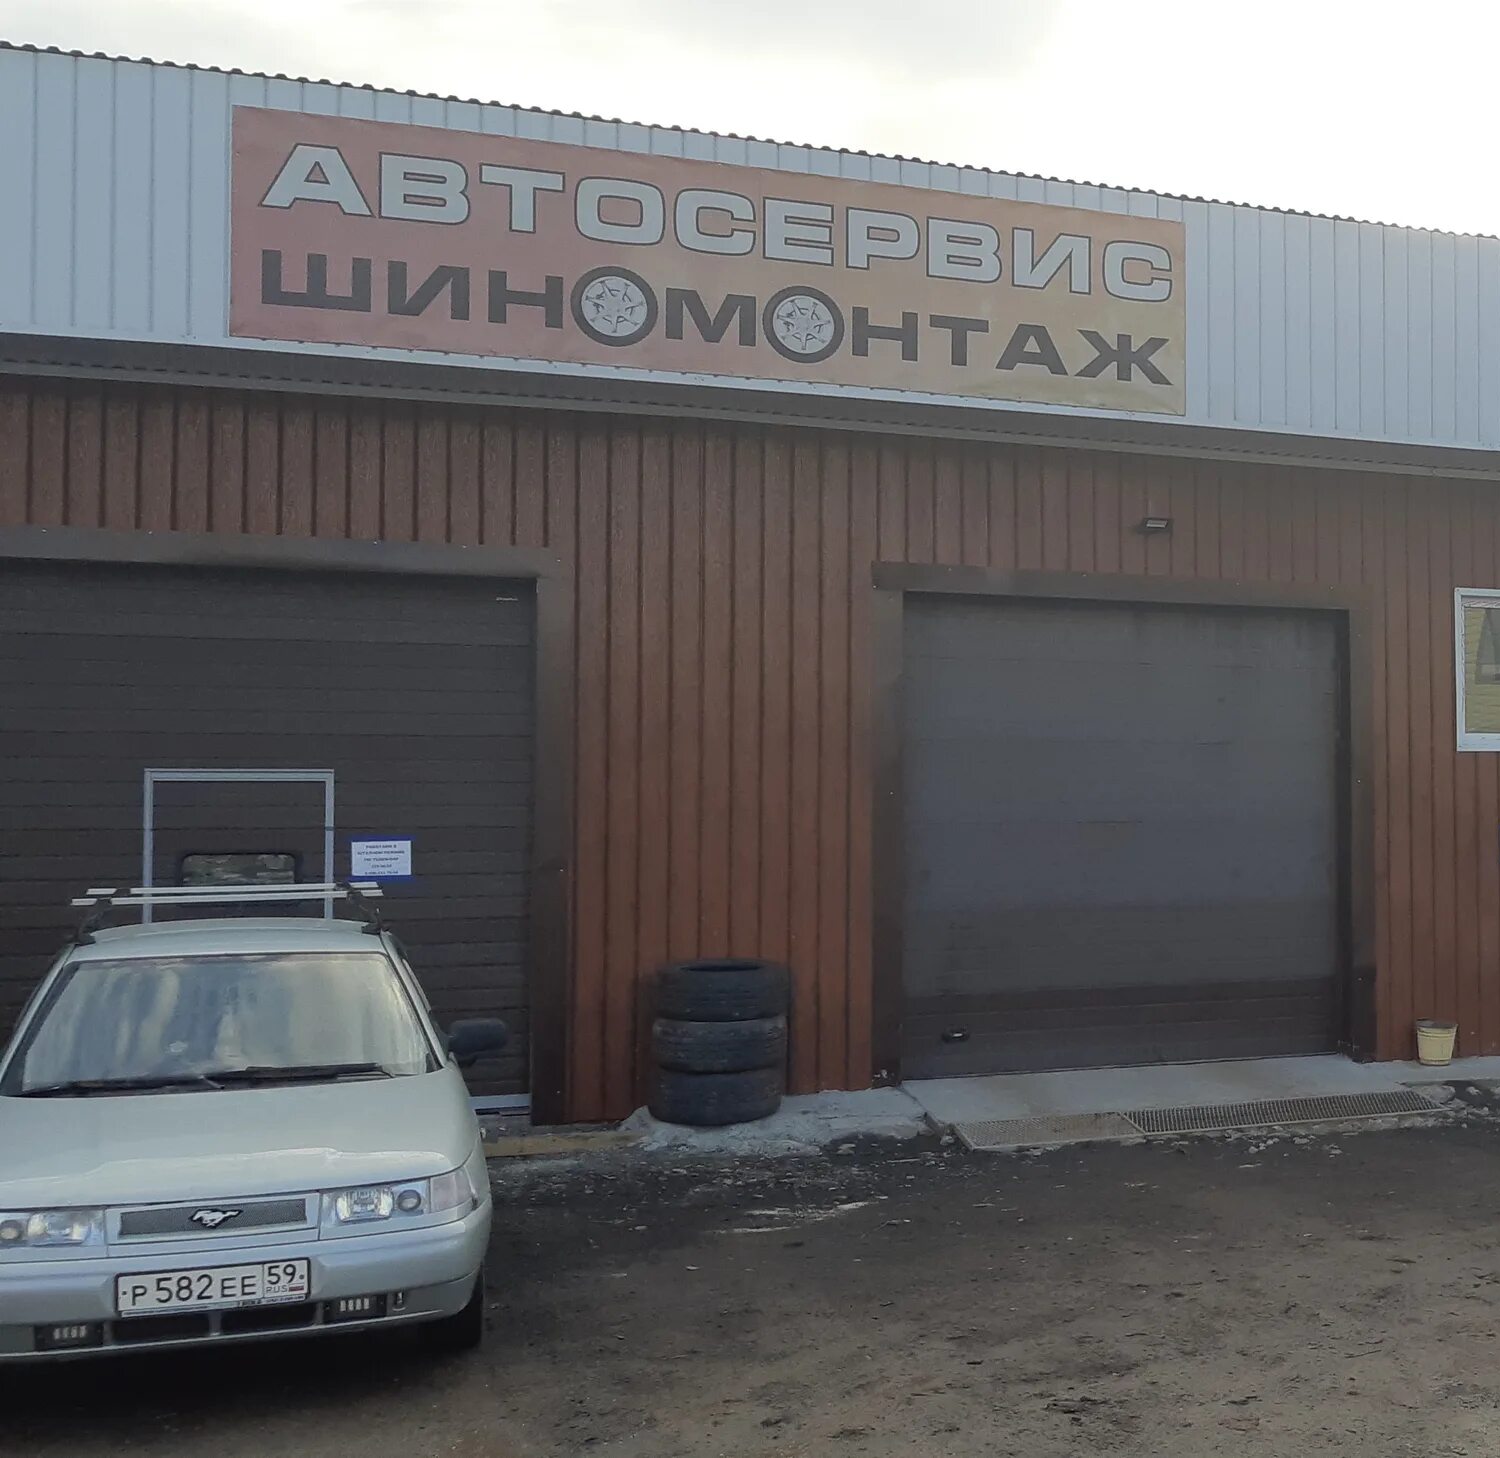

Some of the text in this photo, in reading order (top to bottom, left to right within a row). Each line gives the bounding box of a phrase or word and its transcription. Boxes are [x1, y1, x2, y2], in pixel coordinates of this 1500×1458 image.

[260, 141, 1173, 304] АВТОСЕРВИС
[260, 248, 1174, 386] ШИНОМОНТАЖ
[265, 1285, 288, 1294] RUS
[266, 1263, 297, 1285] 59
